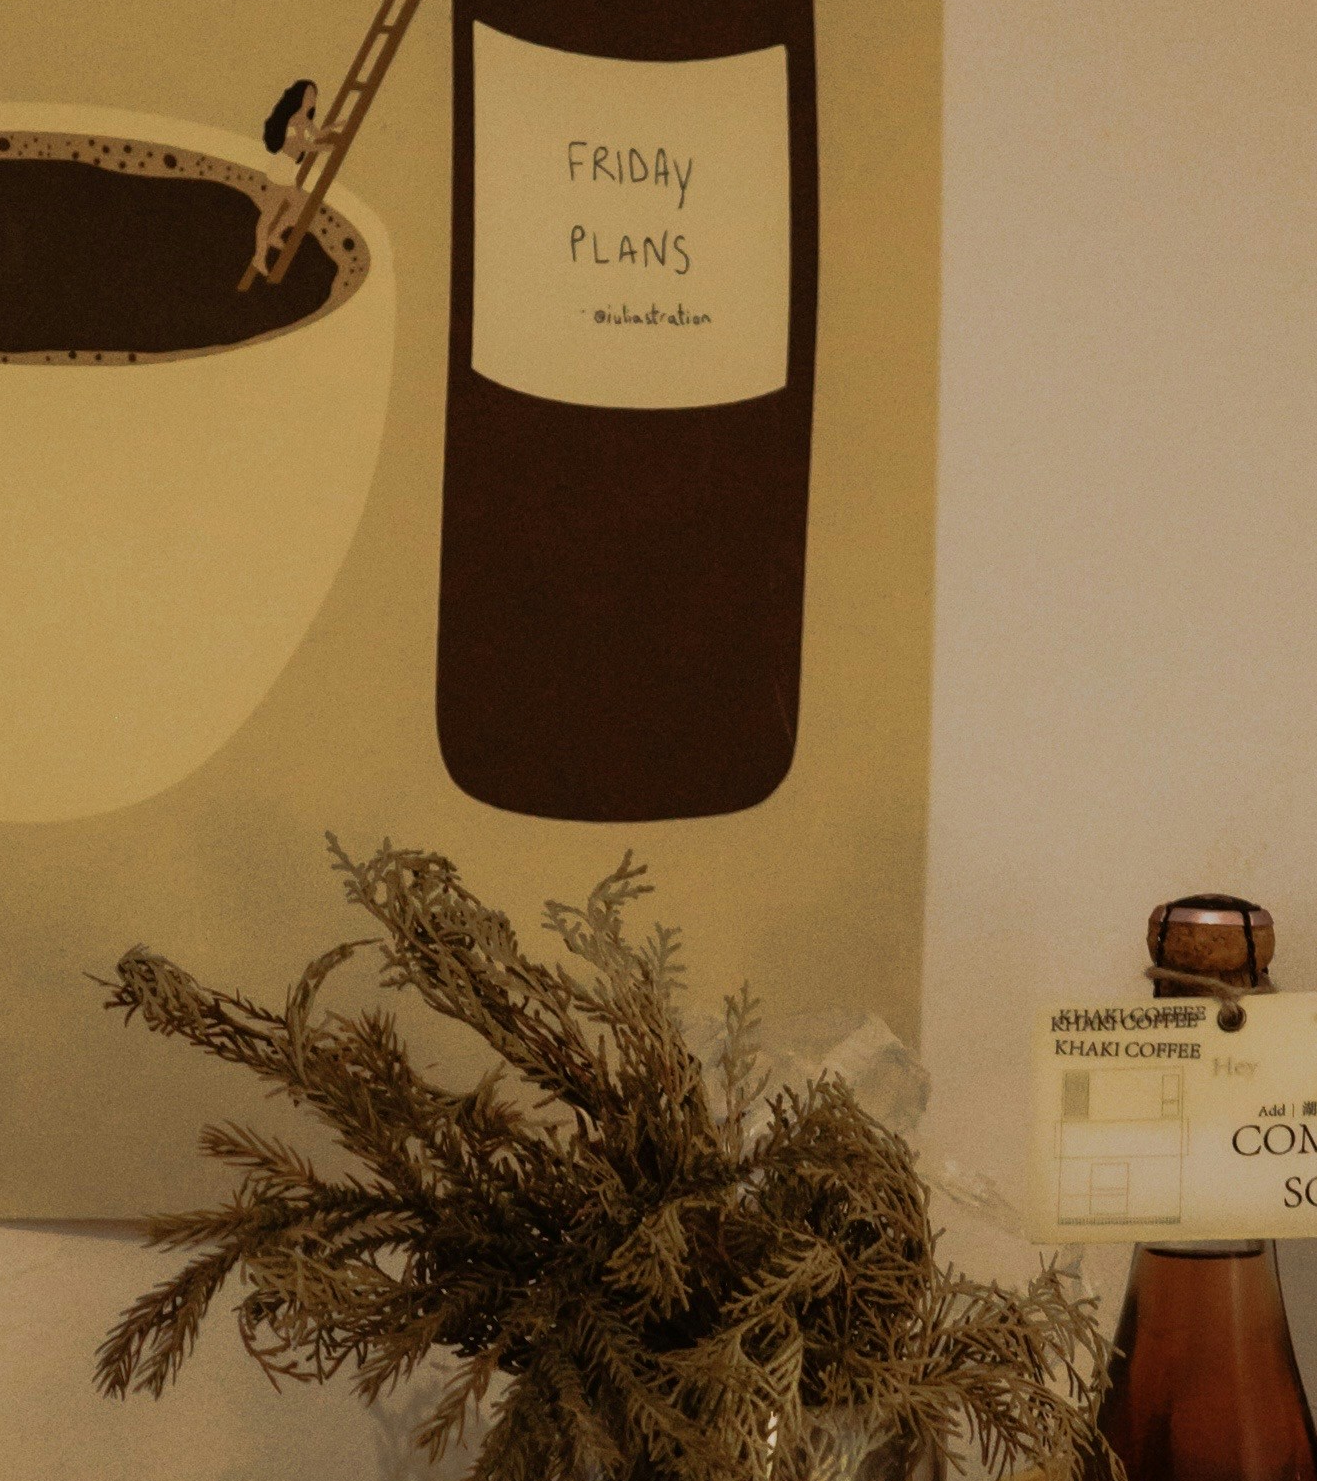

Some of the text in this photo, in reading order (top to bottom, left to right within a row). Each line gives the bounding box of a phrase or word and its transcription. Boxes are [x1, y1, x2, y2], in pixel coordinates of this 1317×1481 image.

[567, 141, 694, 210] FRIDAY
[569, 224, 692, 275] PLANS
[1054, 1039, 1202, 1059] KHAKI COFFEE
[1213, 1057, 1258, 1080] Hey
[1258, 1103, 1286, 1117] Add
